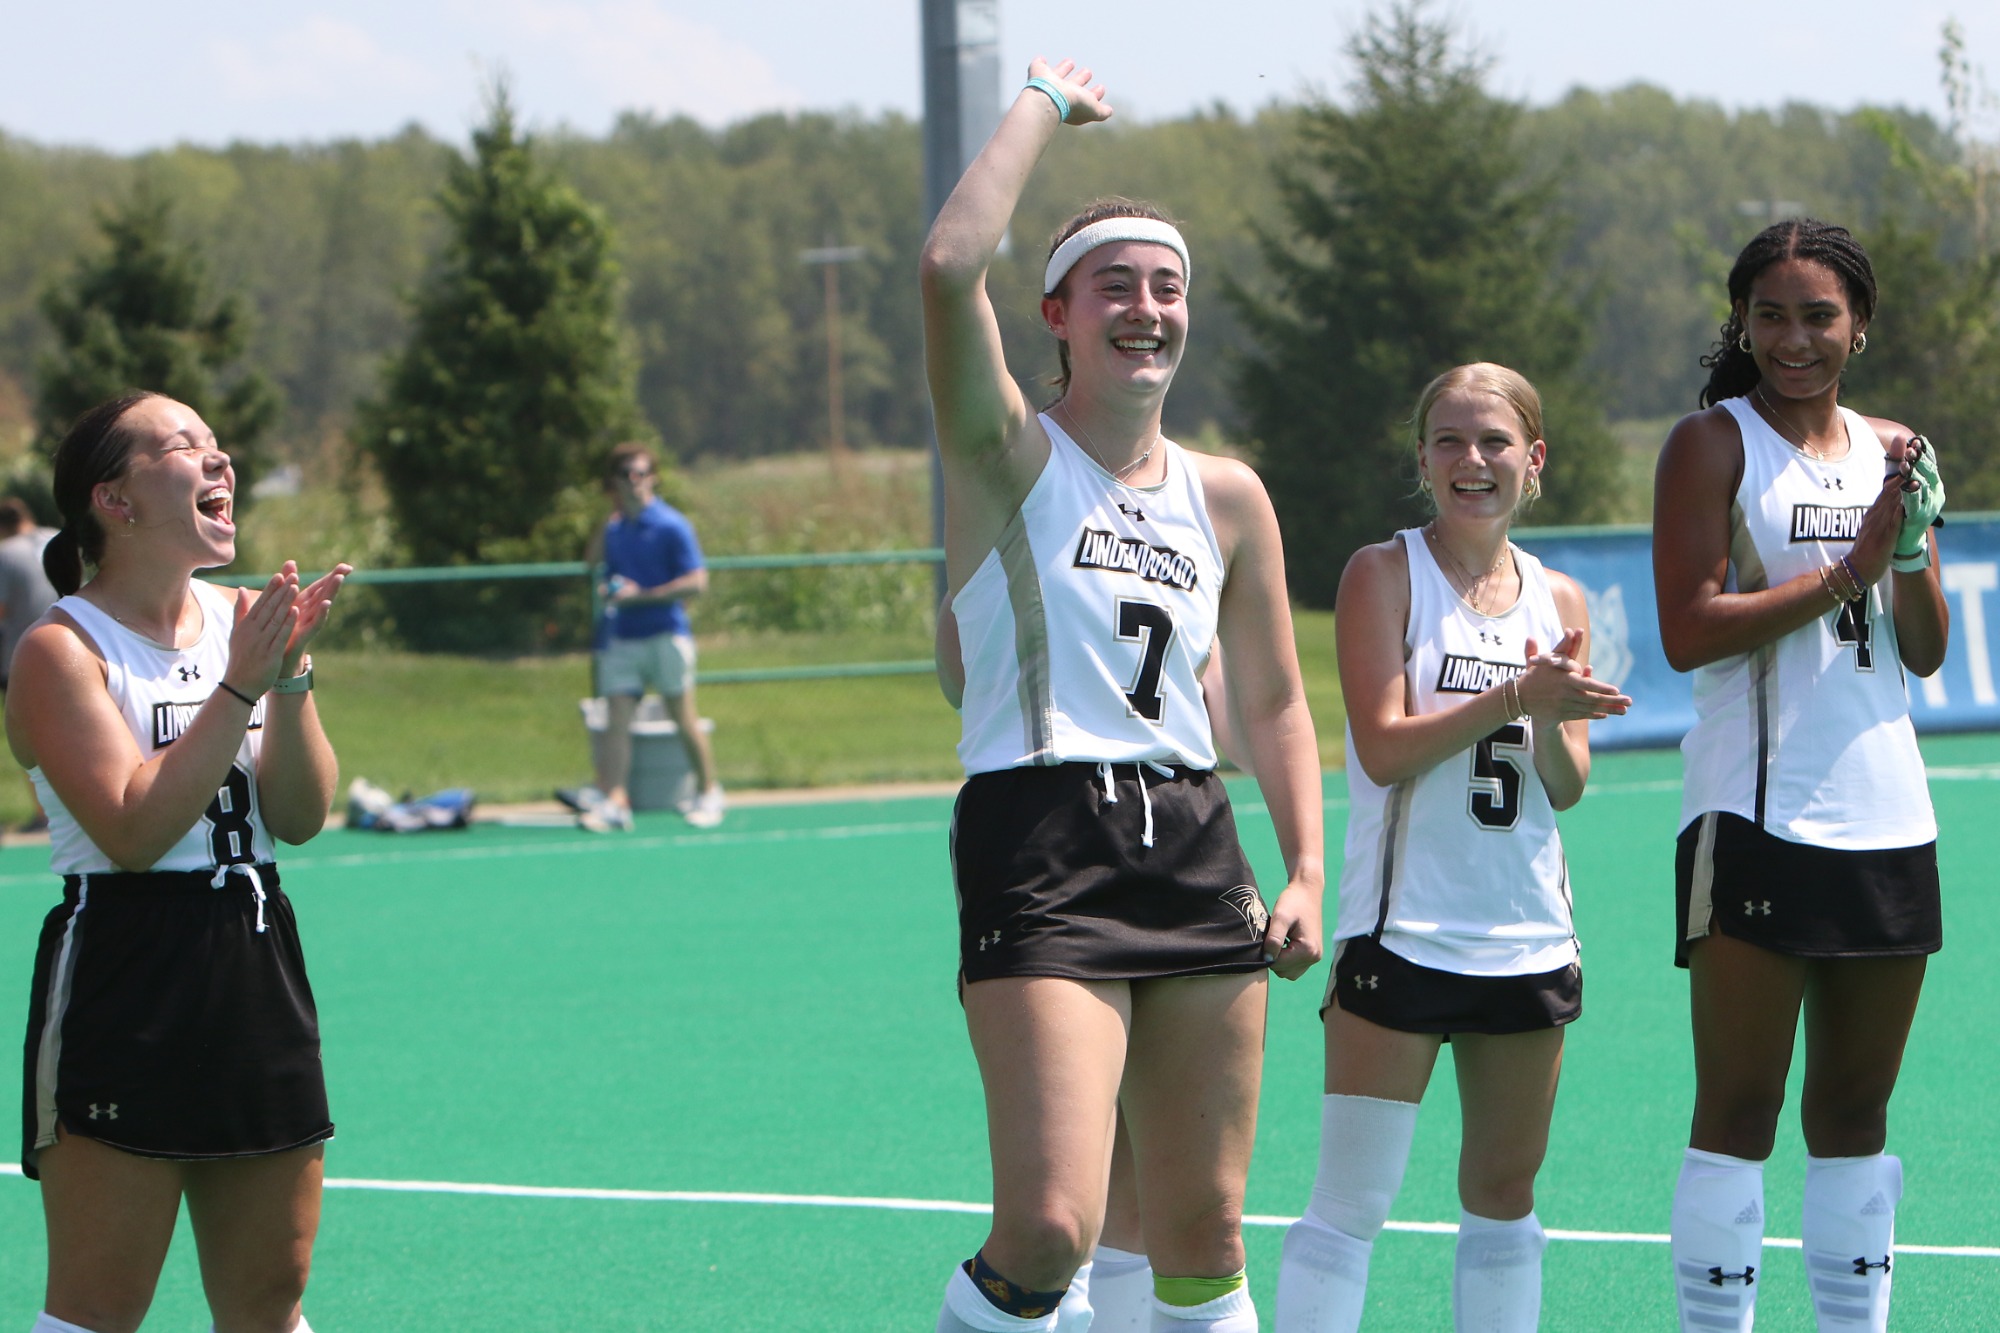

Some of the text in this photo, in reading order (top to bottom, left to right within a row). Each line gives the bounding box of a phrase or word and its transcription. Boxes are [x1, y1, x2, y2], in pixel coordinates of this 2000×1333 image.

[1078, 530, 1197, 590] LINDENWOOD
[1115, 597, 1175, 725] 7
[1834, 586, 1873, 670] 4
[203, 761, 258, 865] 8
[1468, 721, 1529, 830] 5
